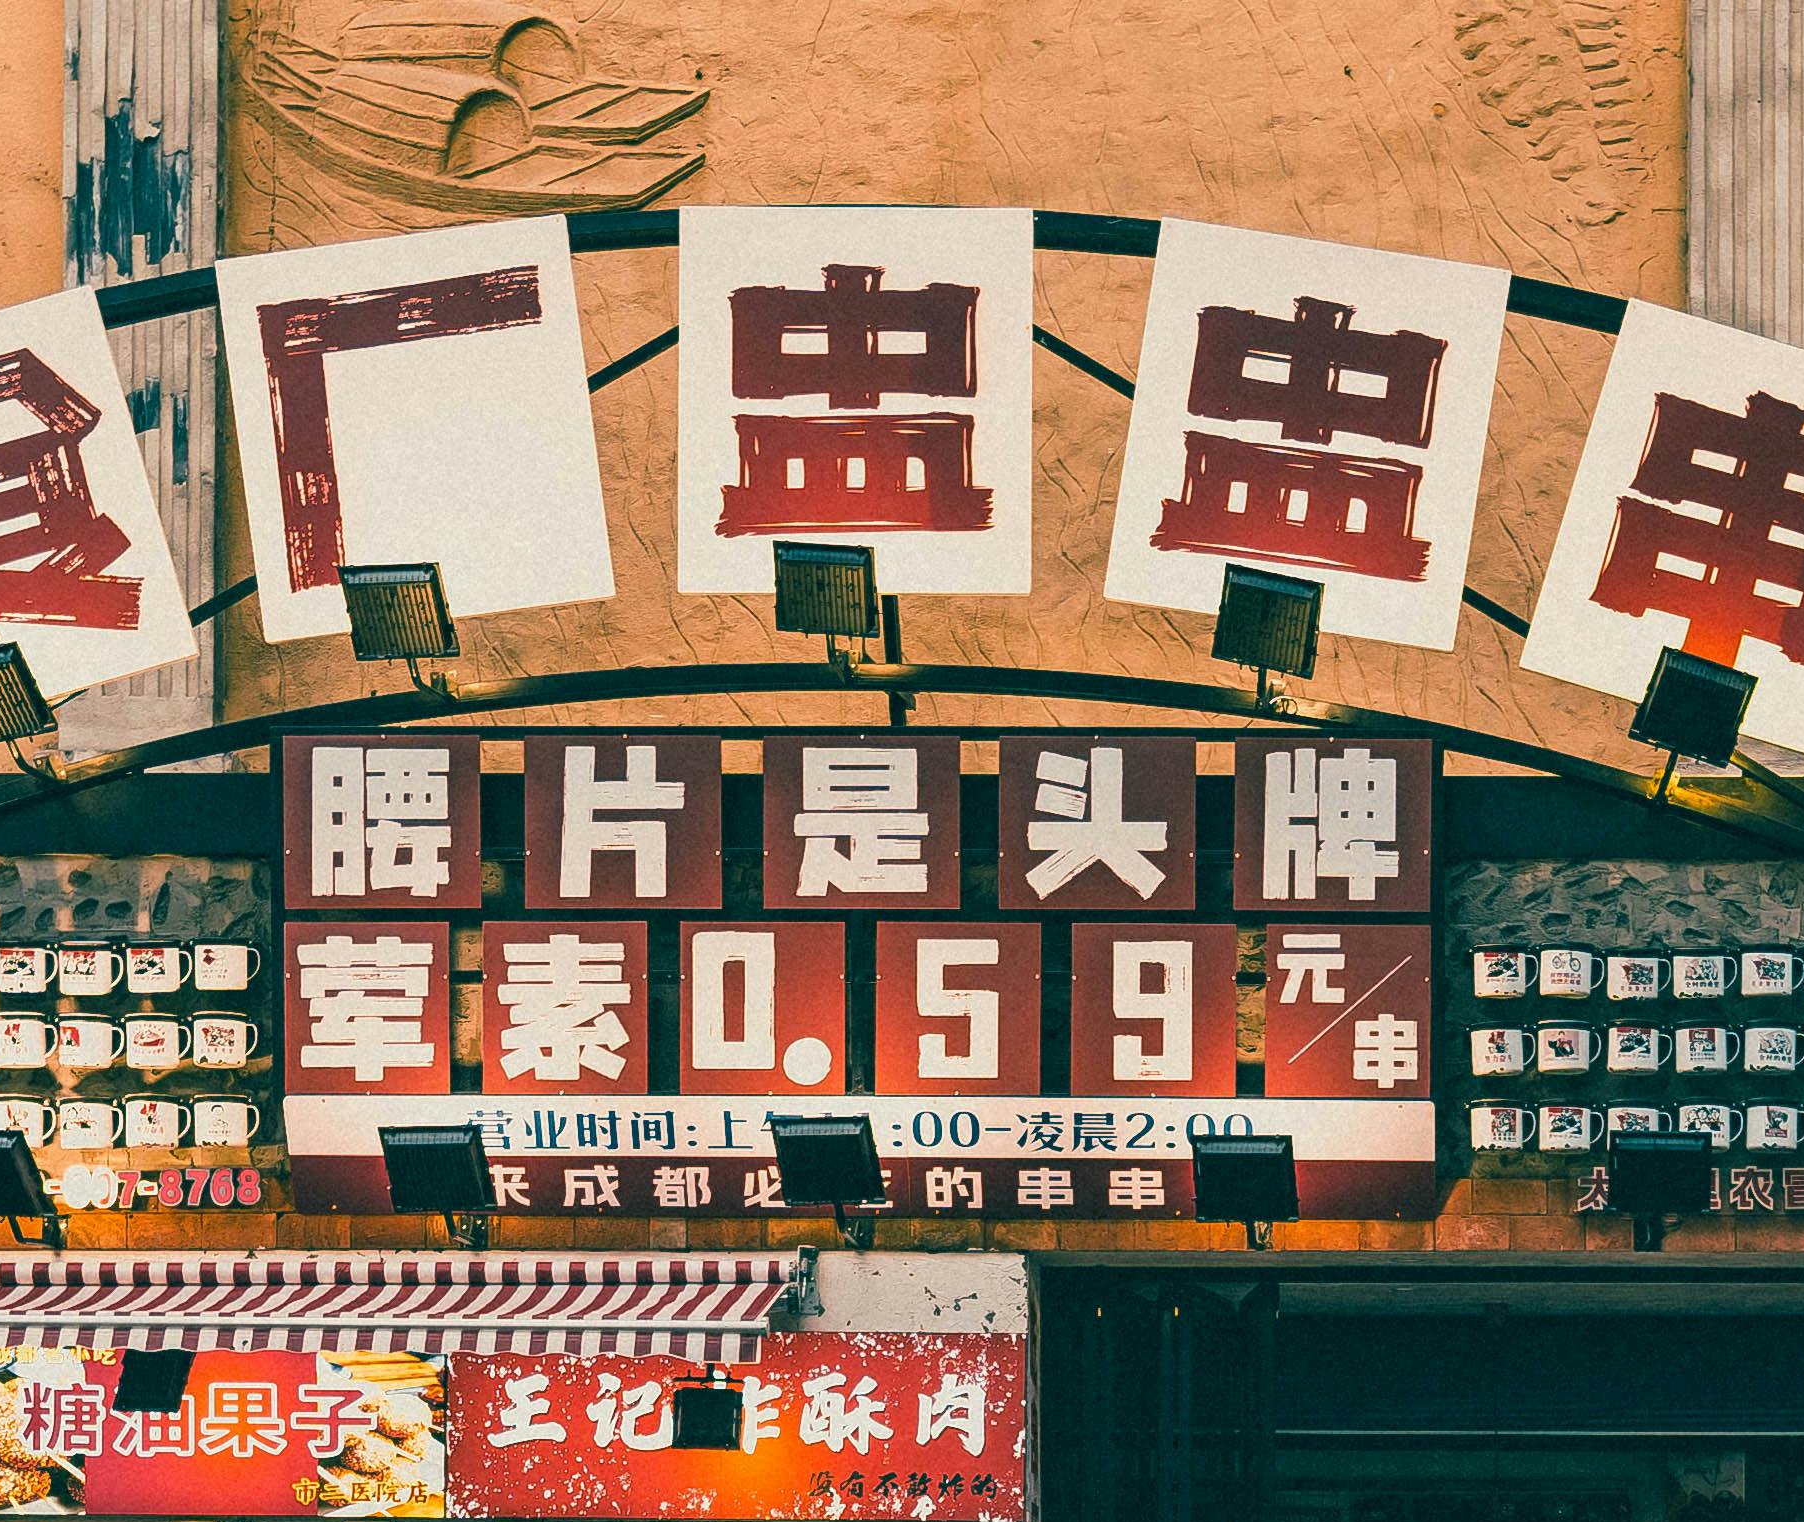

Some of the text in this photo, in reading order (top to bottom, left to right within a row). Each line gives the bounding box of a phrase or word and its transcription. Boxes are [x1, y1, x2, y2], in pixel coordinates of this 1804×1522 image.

[309, 744, 1400, 901] 腰片是头牌
[808, 1471, 999, 1500] 没有不敢炸的
